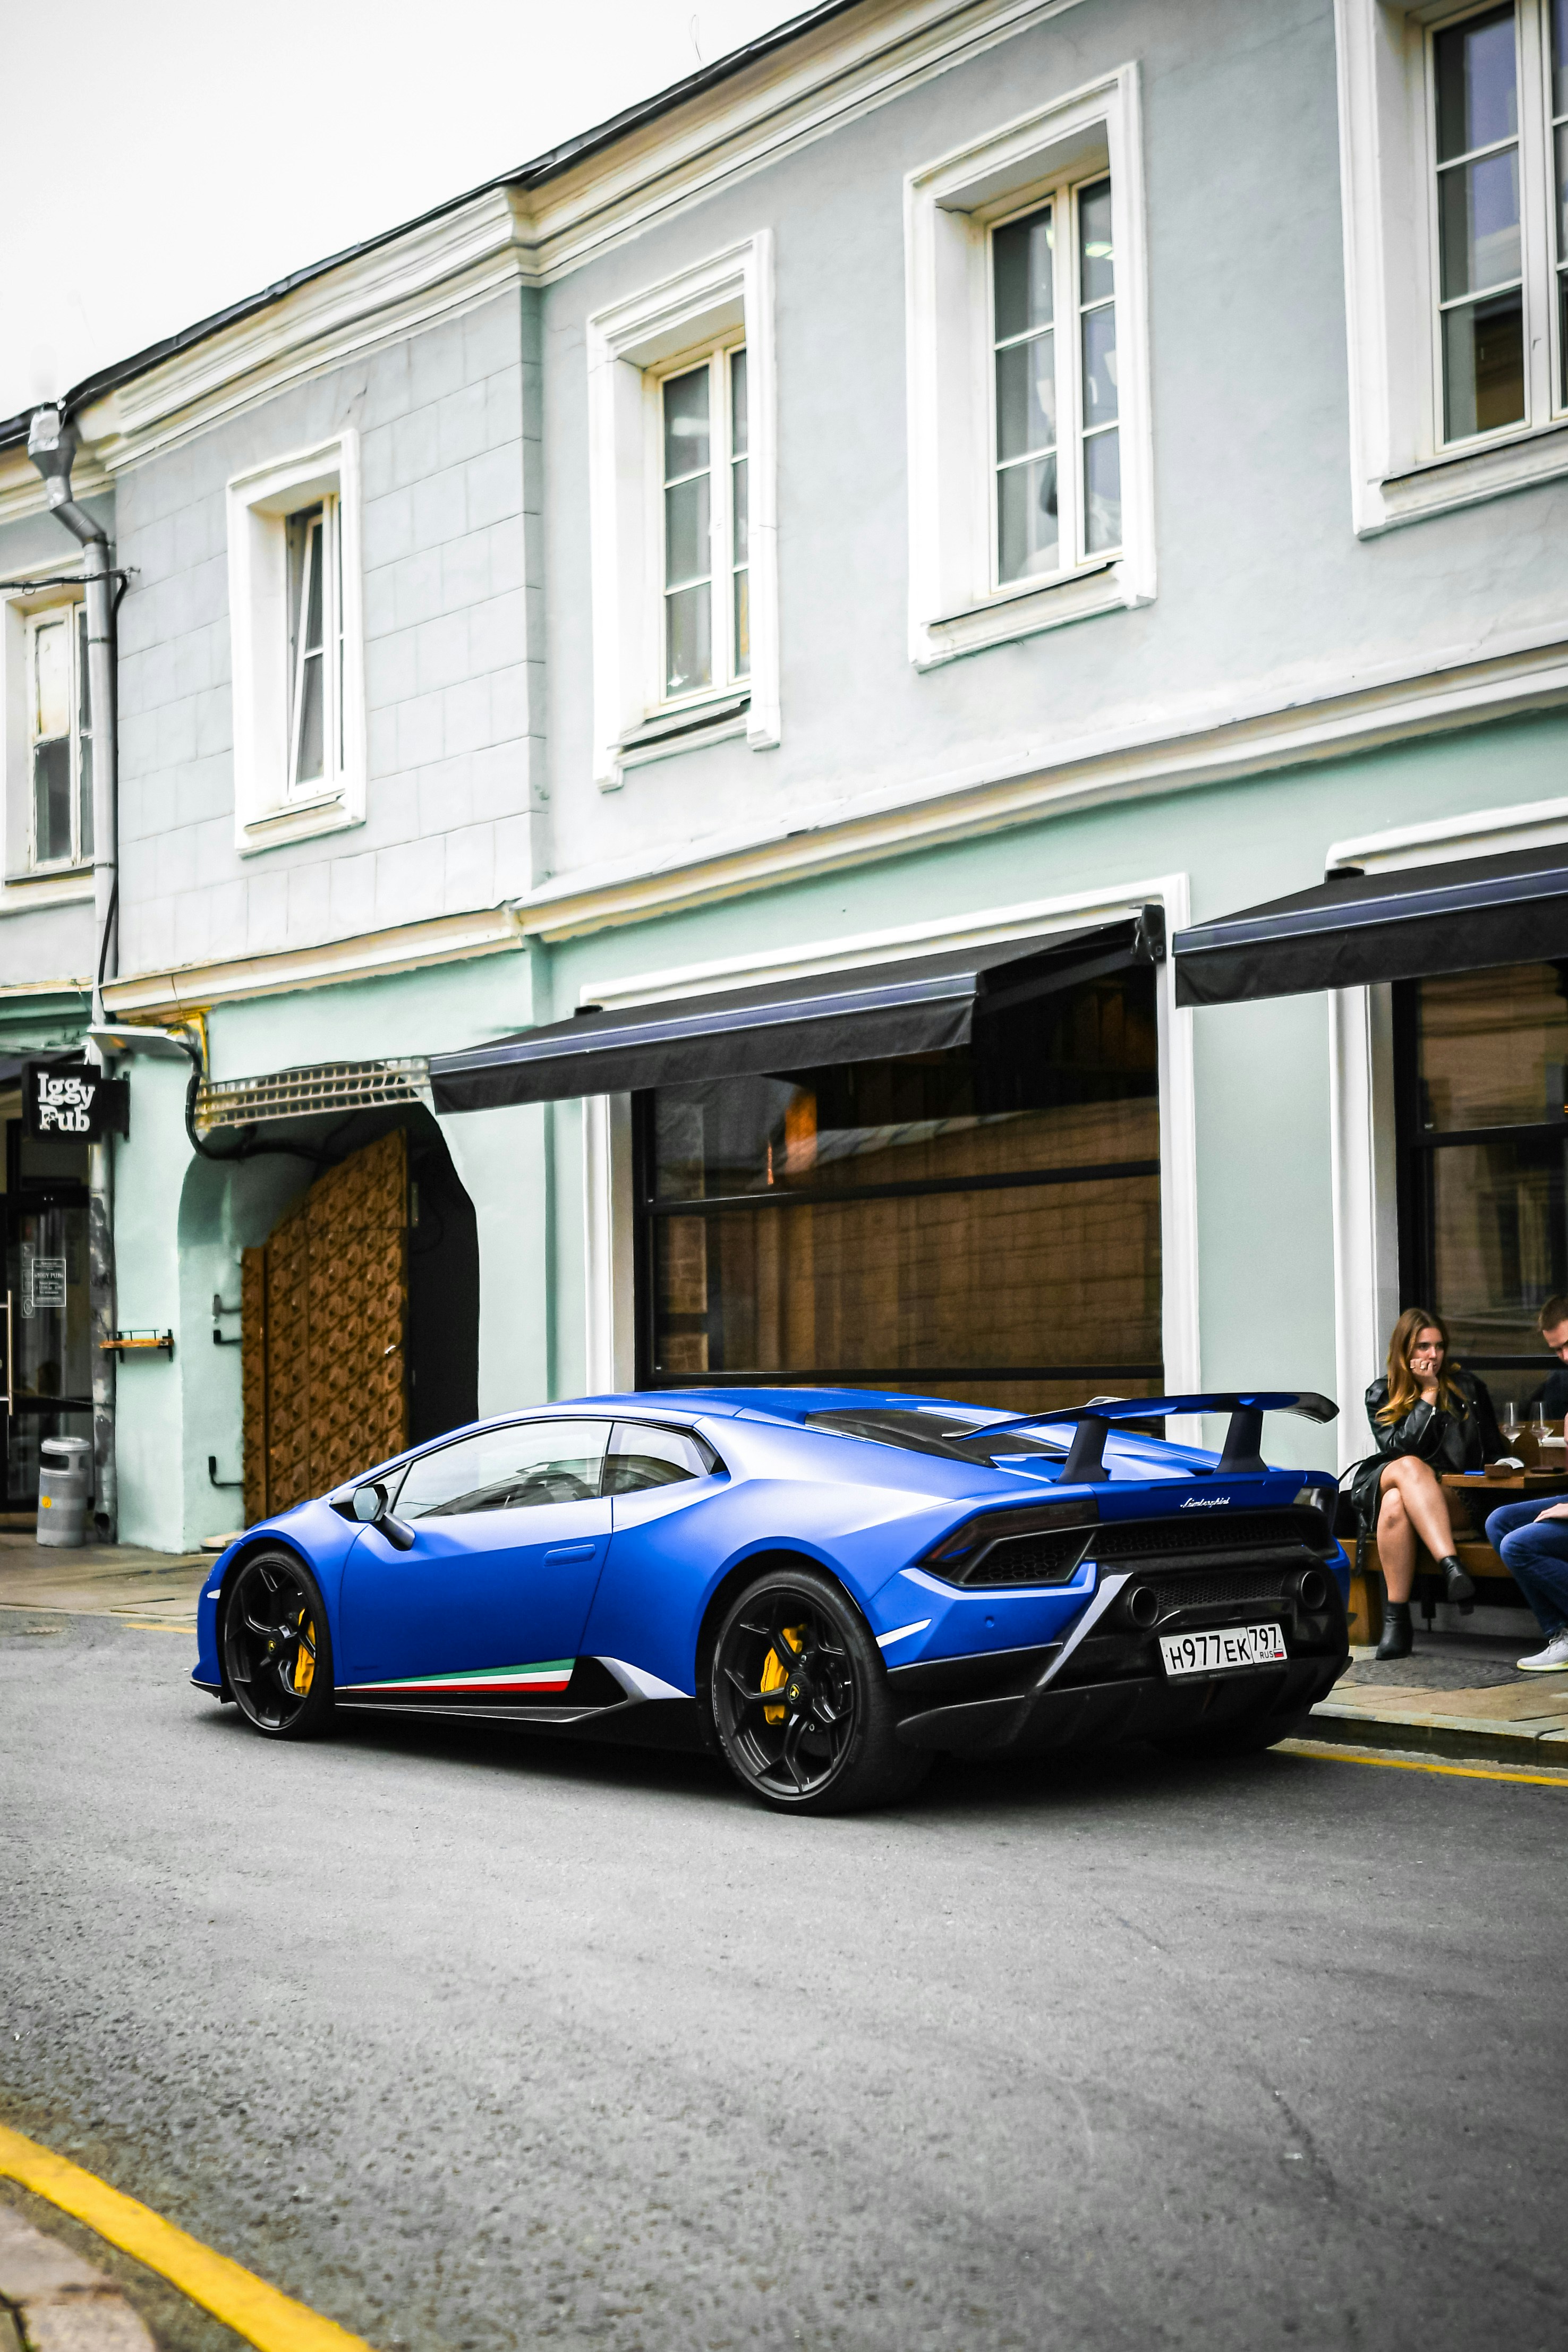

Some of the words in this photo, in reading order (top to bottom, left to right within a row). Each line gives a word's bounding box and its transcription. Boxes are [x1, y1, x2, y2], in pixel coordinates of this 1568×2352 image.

[37, 1072, 96, 1111] Iggy
[39, 1104, 90, 1132] Pub
[1249, 1626, 1277, 1651] 797
[1259, 1650, 1274, 1659] RUS
